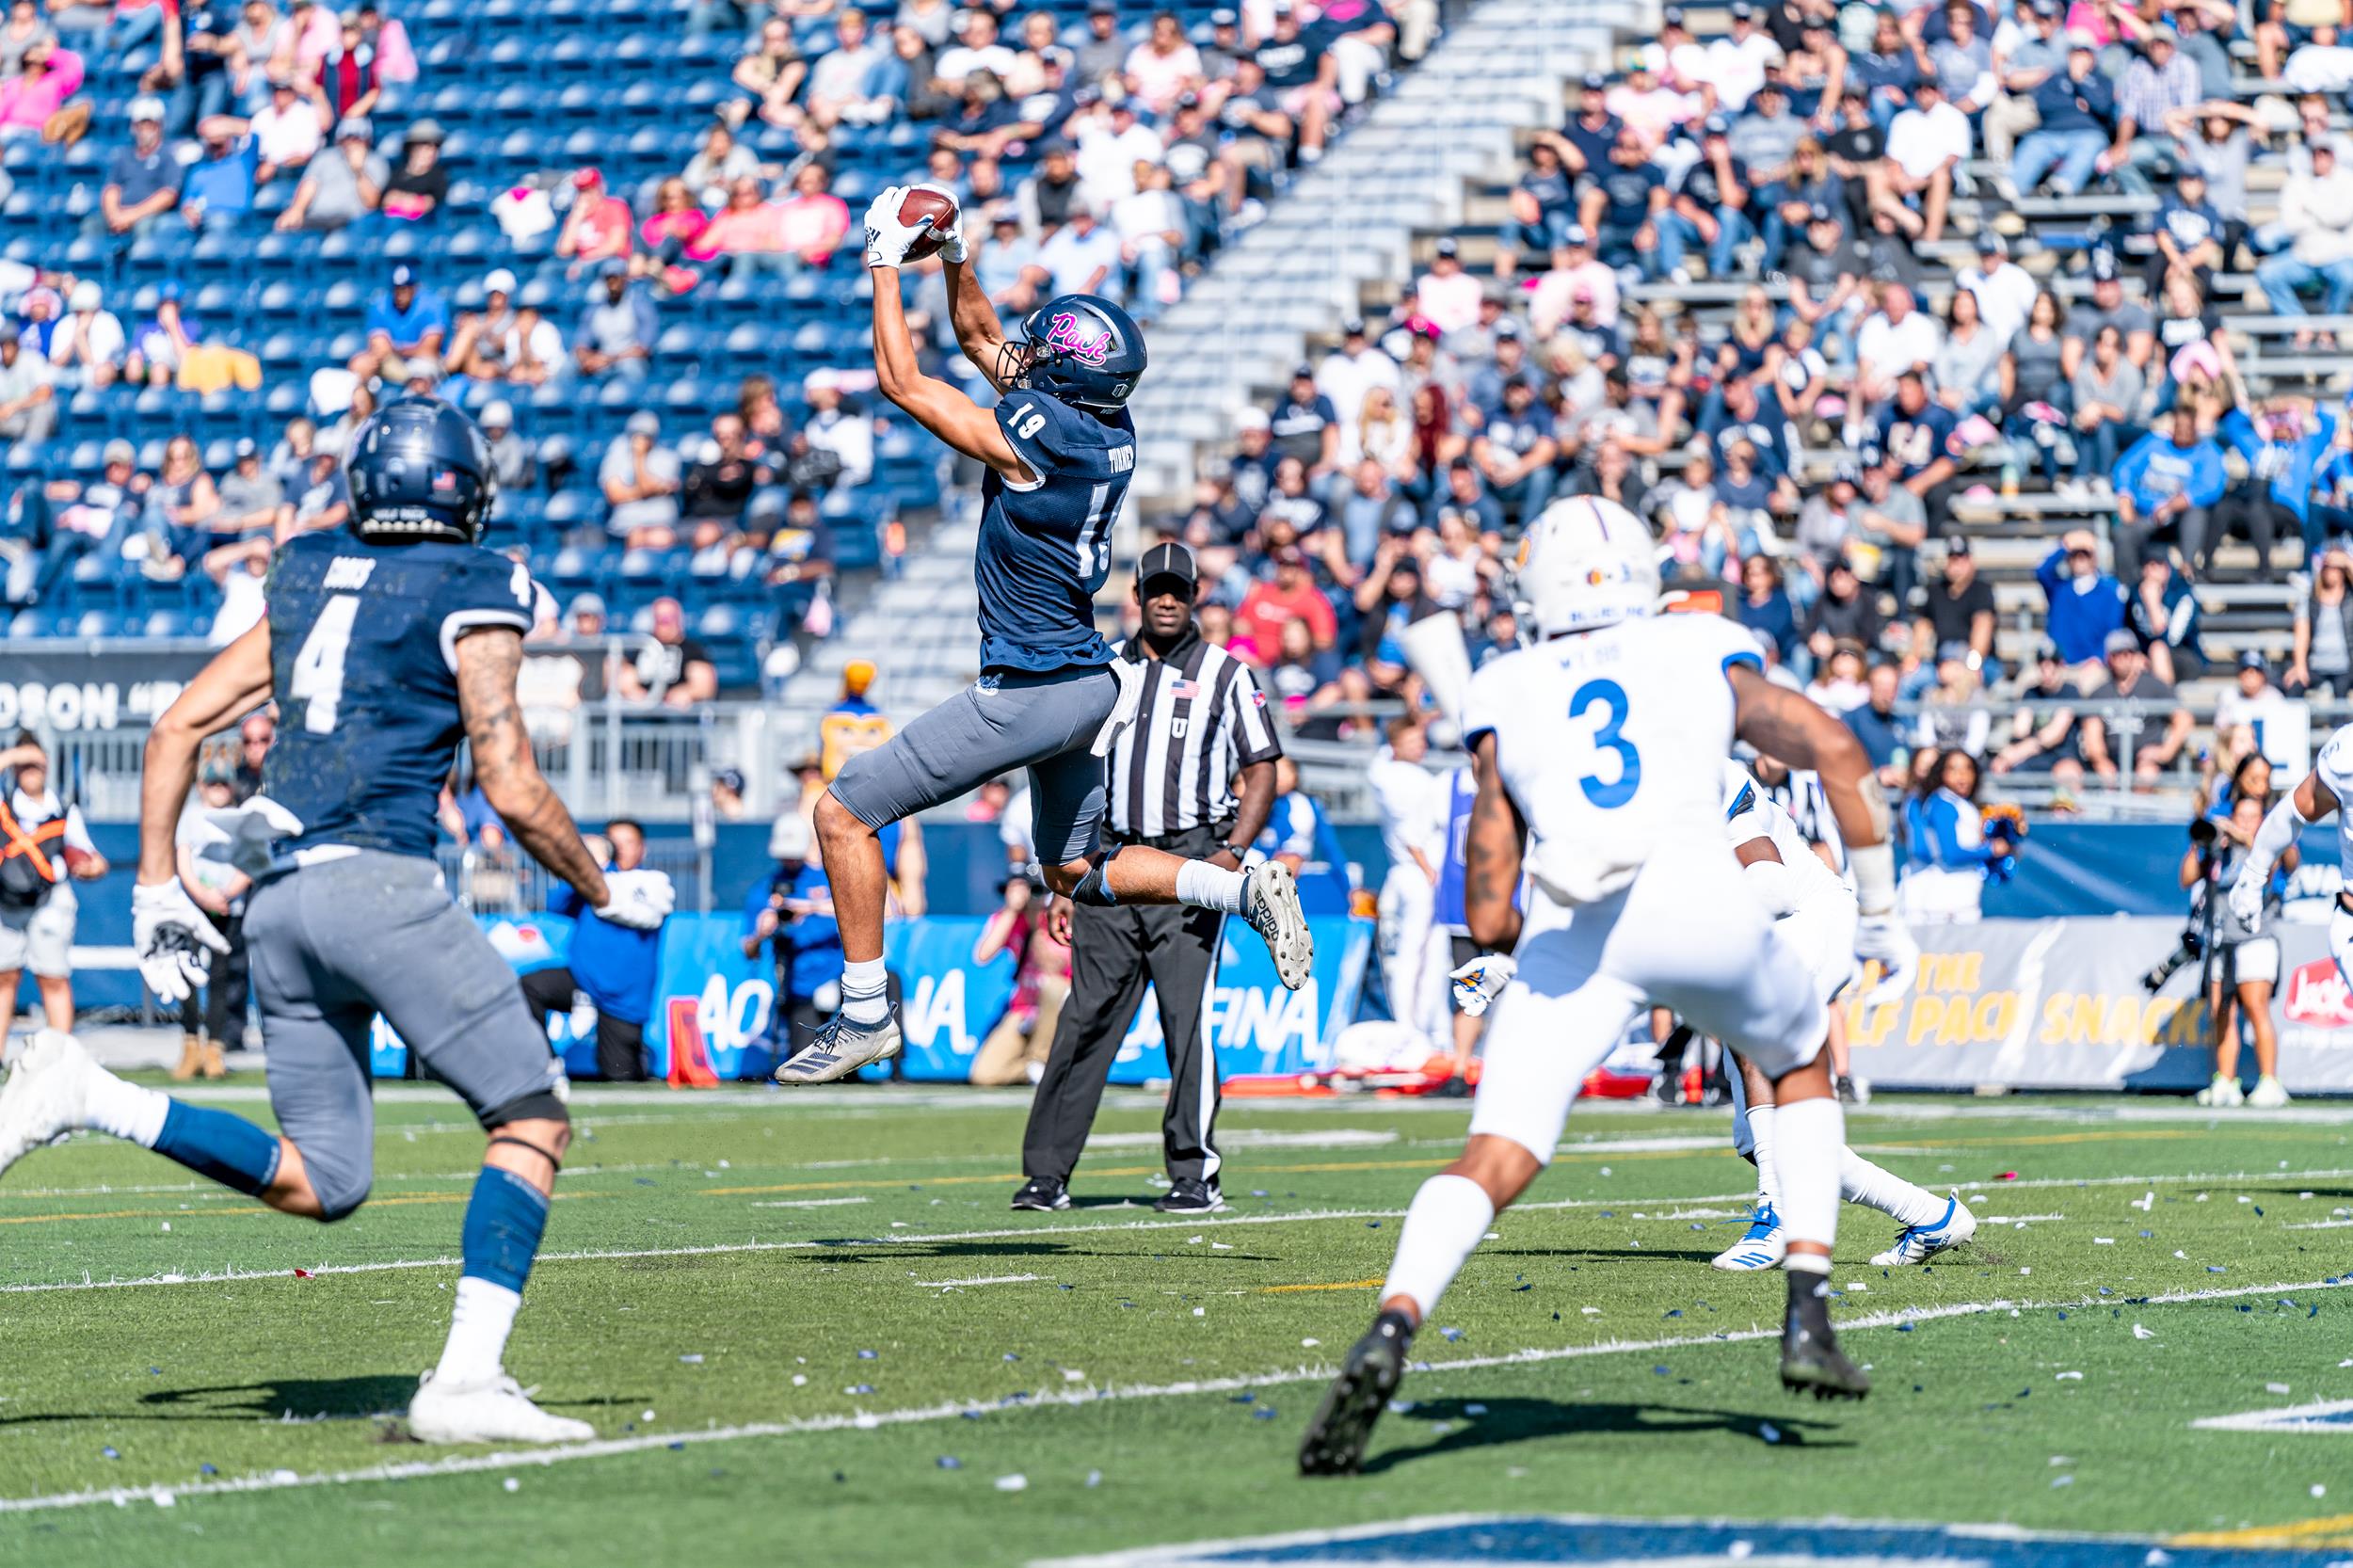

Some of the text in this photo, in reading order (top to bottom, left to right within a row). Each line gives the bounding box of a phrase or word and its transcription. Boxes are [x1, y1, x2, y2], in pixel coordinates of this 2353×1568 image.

[1046, 312, 1112, 366] Pack
[1006, 402, 1047, 440] 19
[291, 593, 361, 735] 4
[1171, 716, 1189, 739] U
[1568, 679, 1641, 810] 3
[1255, 888, 1280, 942] adidas
[1915, 950, 1984, 994] THE
